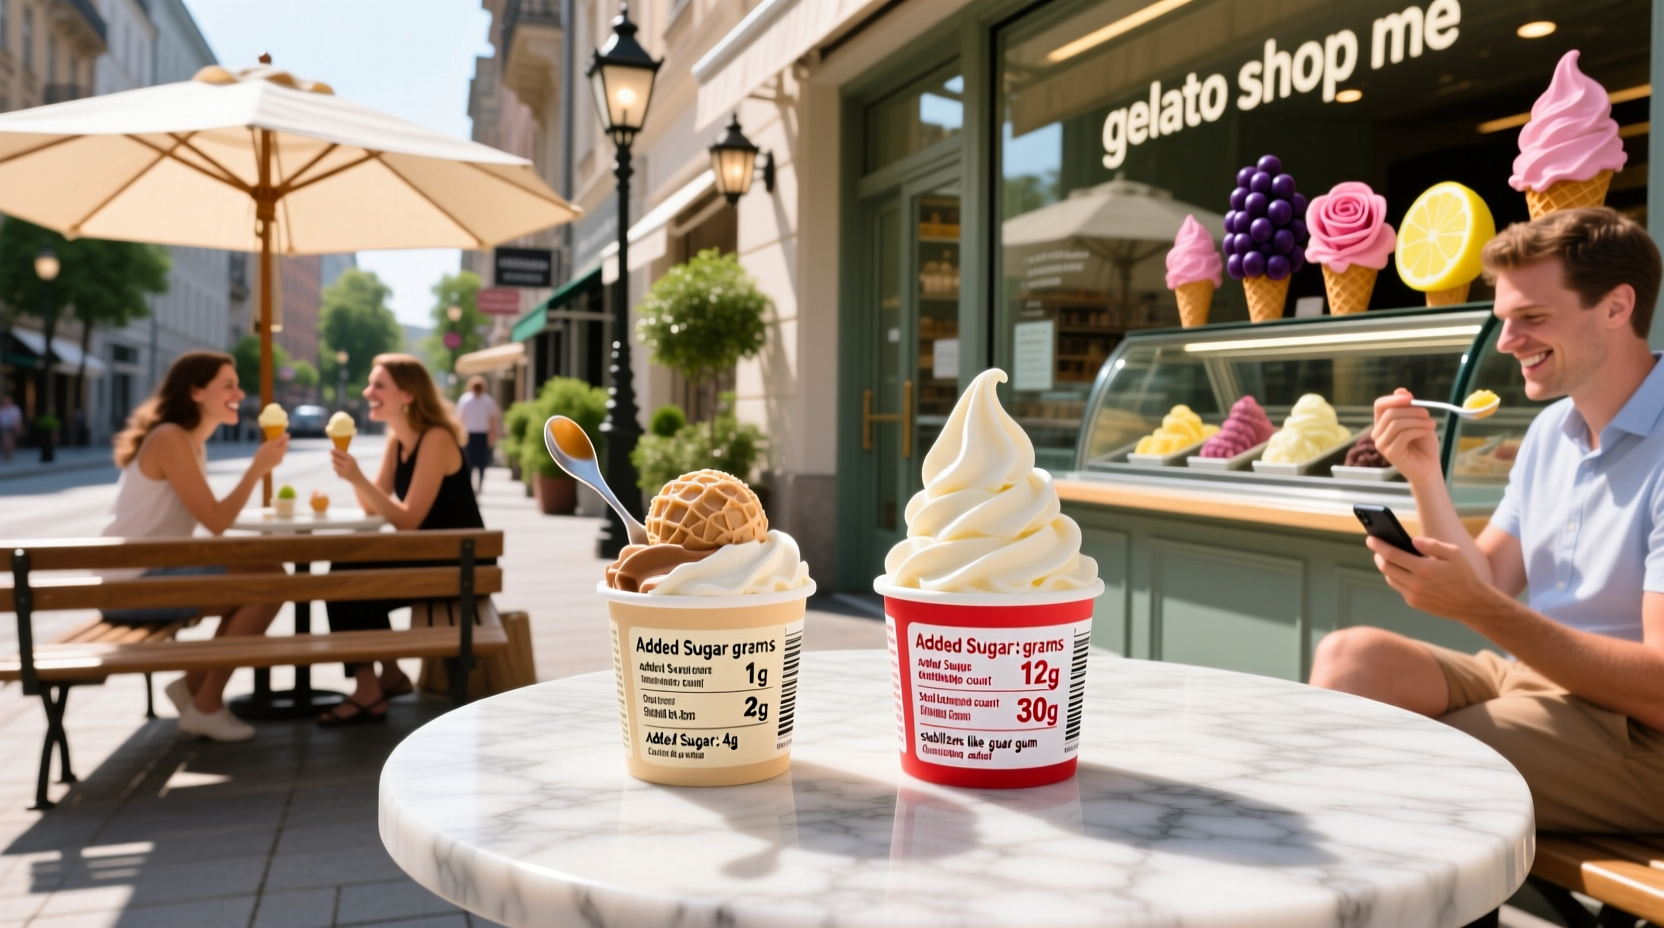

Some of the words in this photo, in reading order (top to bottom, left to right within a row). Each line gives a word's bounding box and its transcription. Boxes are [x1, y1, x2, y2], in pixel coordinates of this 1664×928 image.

[1102, 72, 1228, 170] gelato
[1237, 29, 1359, 112] shop
[1371, 0, 1461, 70] me
[636, 636, 679, 655] Added
[684, 640, 728, 660] Sugar
[732, 639, 776, 659] grams
[916, 632, 962, 653] Added
[967, 637, 1020, 659] Sugar:
[1023, 638, 1064, 658] grams
[745, 661, 768, 687] 1g
[1021, 659, 1060, 691] 12g
[743, 696, 768, 721] 2g
[1016, 697, 1059, 726] 30g
[680, 733, 720, 751] Sugar:
[722, 733, 738, 750] 4g
[967, 735, 985, 748] like
[989, 739, 1012, 752] guar
[1015, 738, 1038, 753] gum
